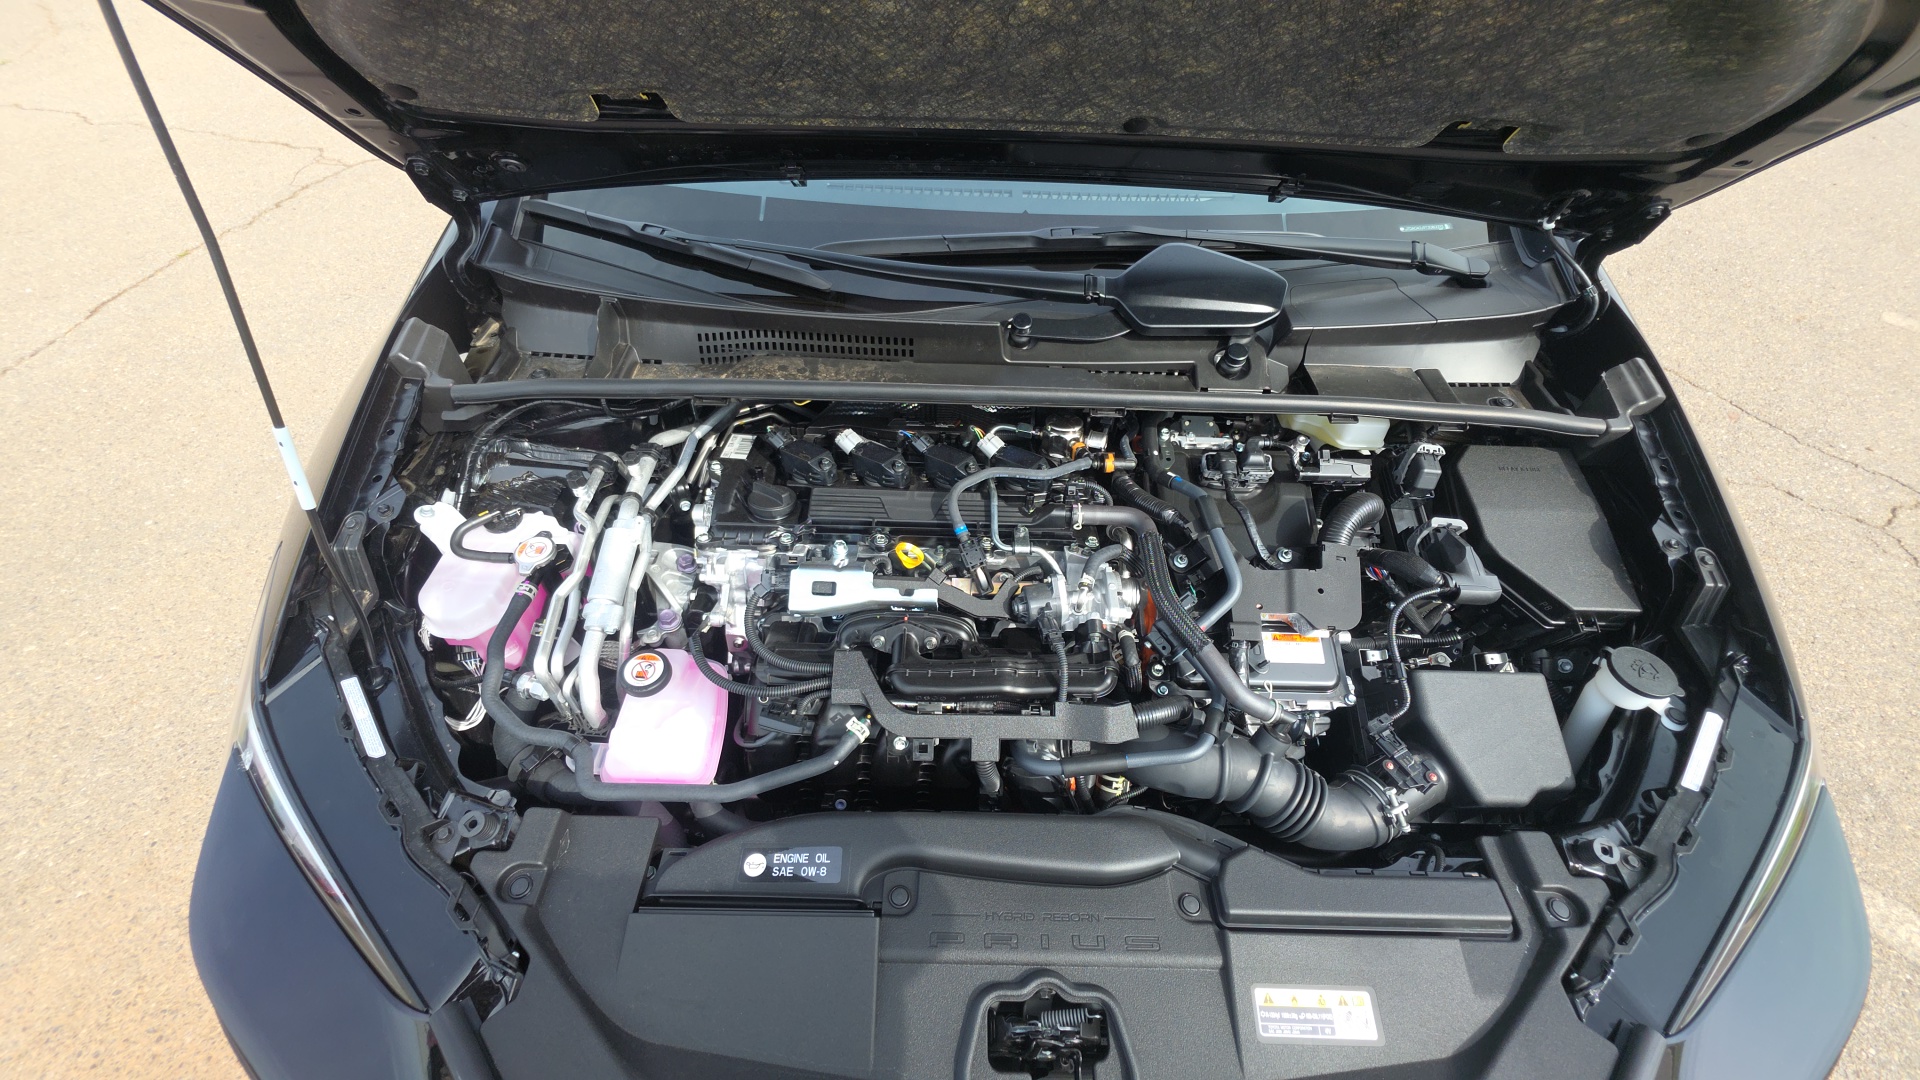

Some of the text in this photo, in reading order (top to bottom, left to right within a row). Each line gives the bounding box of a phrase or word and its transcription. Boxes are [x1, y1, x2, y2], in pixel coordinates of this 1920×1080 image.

[773, 853, 831, 864] ENGINE OIL
[771, 866, 827, 877] SAE 0W-8
[985, 912, 1100, 923] HYBRID REBORN
[928, 931, 1161, 952] PRIUS
